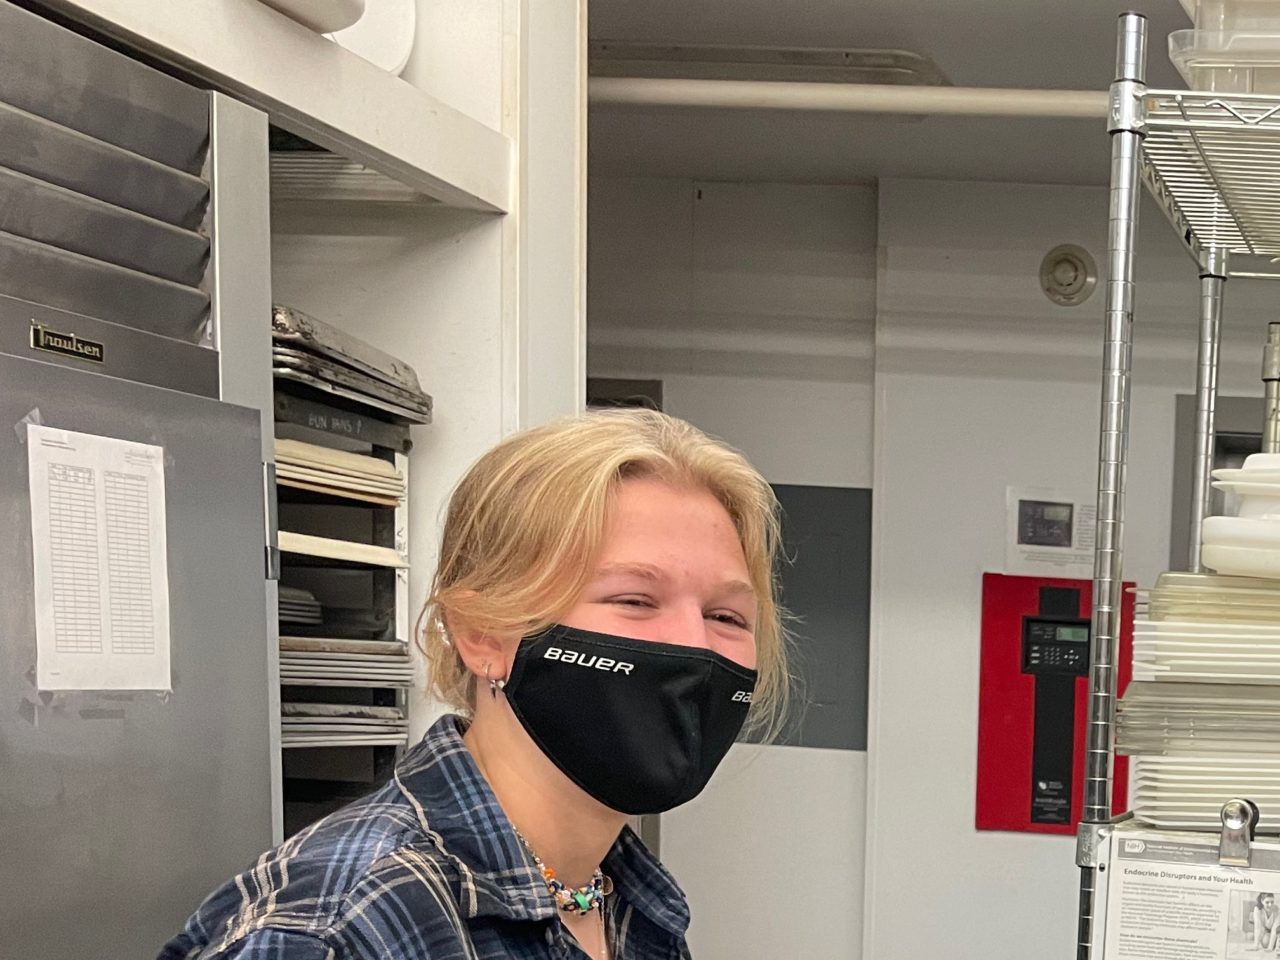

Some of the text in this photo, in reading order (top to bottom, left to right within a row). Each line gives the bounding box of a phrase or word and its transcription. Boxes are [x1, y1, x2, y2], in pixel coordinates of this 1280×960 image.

[31, 319, 101, 357] Traulsen
[543, 647, 635, 676] BAUER
[1123, 867, 1254, 885] Endocrine Disruptors and Your Health
